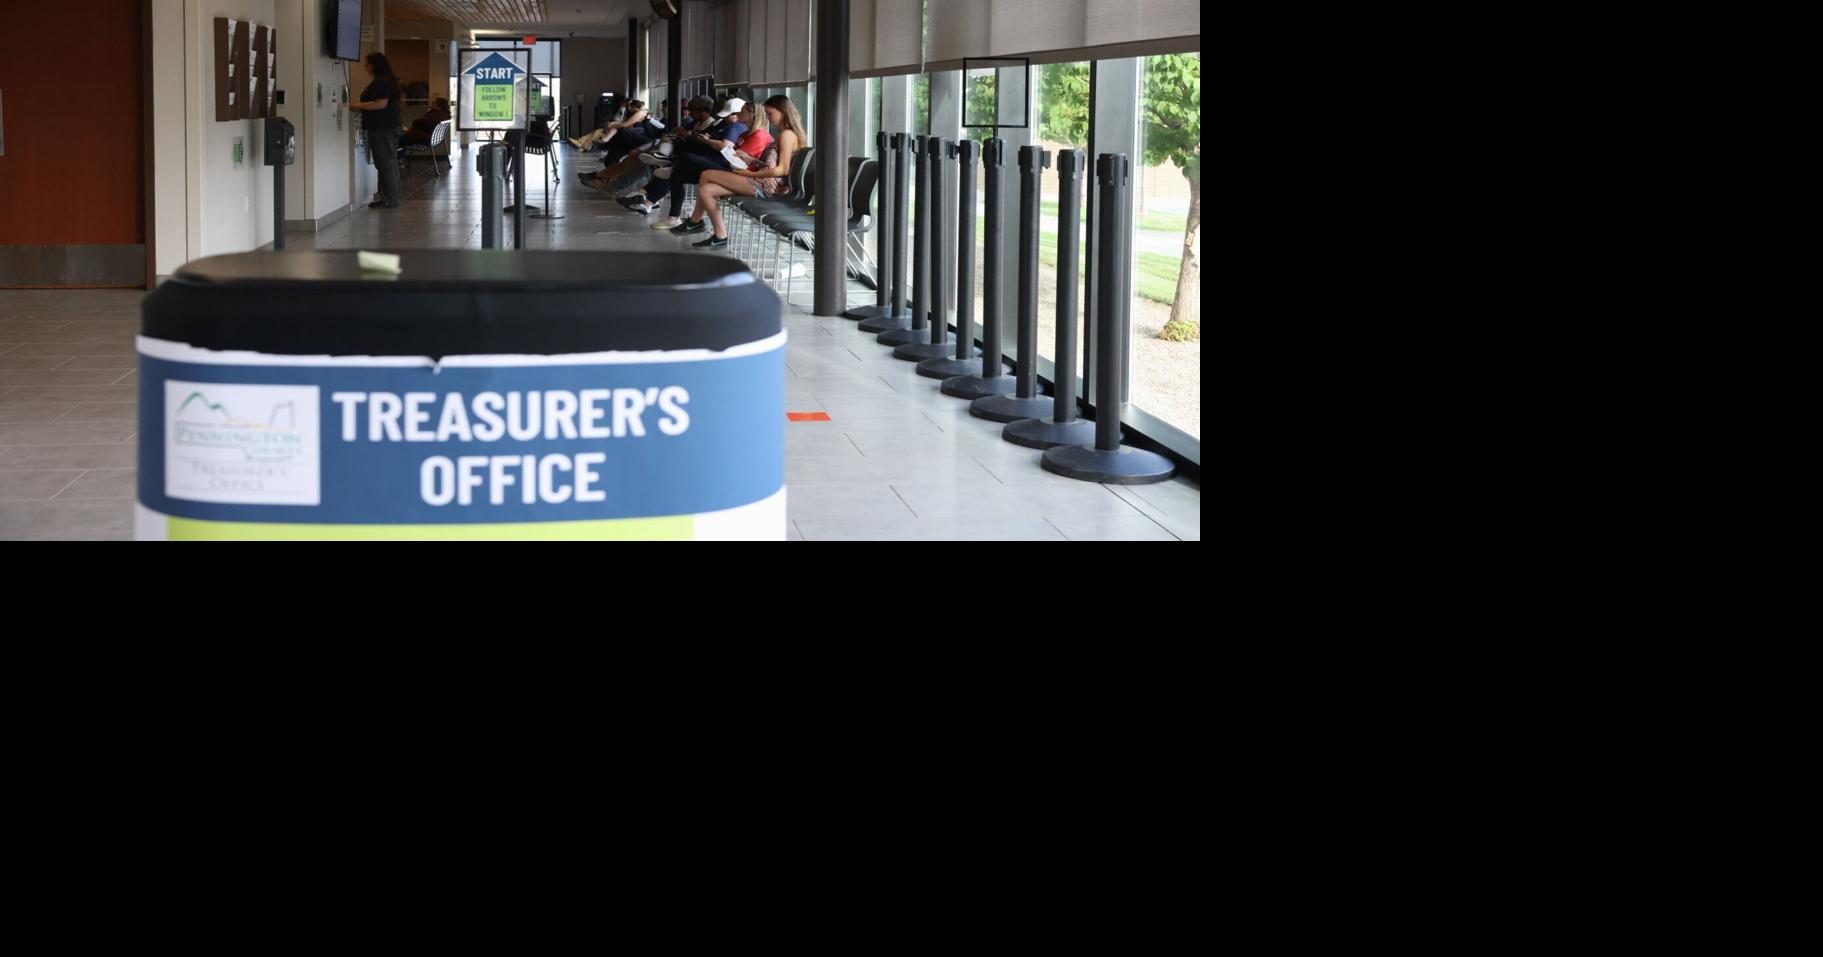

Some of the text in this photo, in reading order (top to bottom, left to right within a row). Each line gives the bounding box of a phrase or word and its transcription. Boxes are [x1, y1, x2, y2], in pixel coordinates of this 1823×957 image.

[476, 68, 513, 79] START
[332, 386, 690, 442] TREASURER'S
[420, 453, 606, 505] OFFICE
